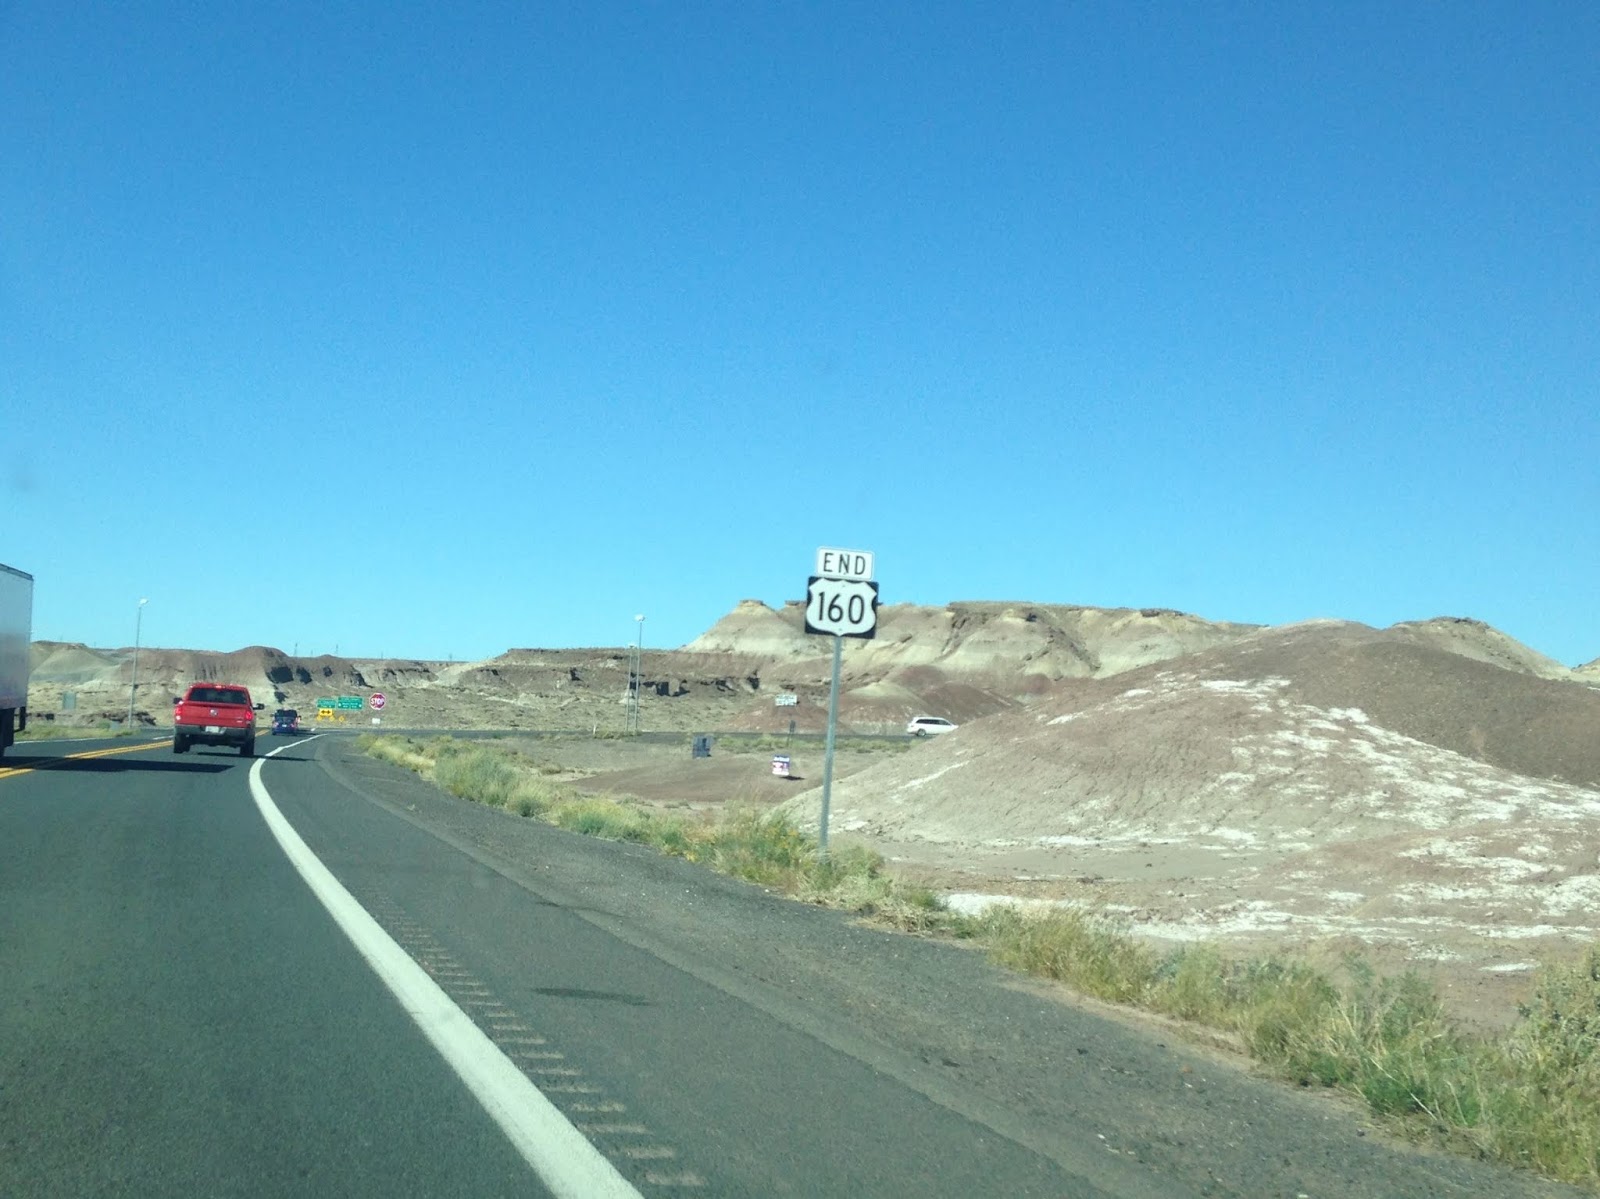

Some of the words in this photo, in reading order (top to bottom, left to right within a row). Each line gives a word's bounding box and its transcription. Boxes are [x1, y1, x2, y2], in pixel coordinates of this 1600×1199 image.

[823, 552, 866, 575] END
[818, 591, 865, 624] 160
[370, 697, 385, 705] STOP
